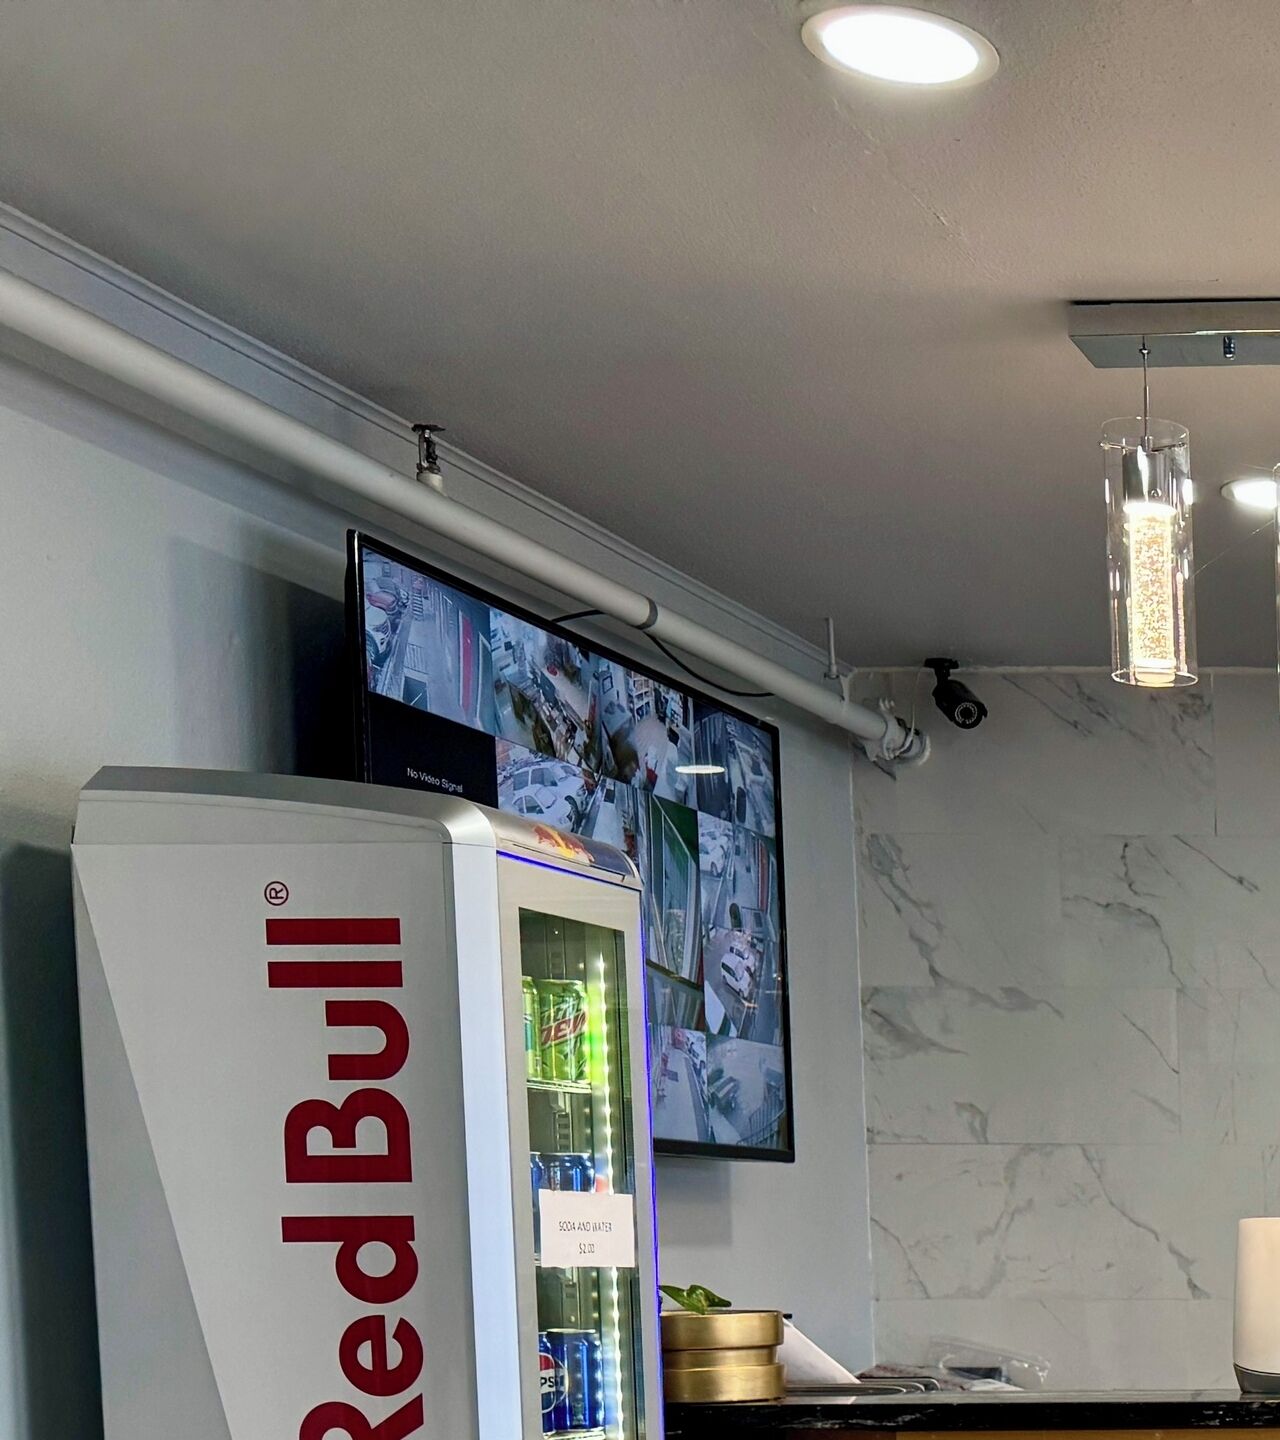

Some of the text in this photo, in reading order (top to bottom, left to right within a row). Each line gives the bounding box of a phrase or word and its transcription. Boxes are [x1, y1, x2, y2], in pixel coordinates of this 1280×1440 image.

[419, 771, 440, 785] Video
[265, 918, 413, 1184] Bull
[577, 1221, 592, 1232] AND
